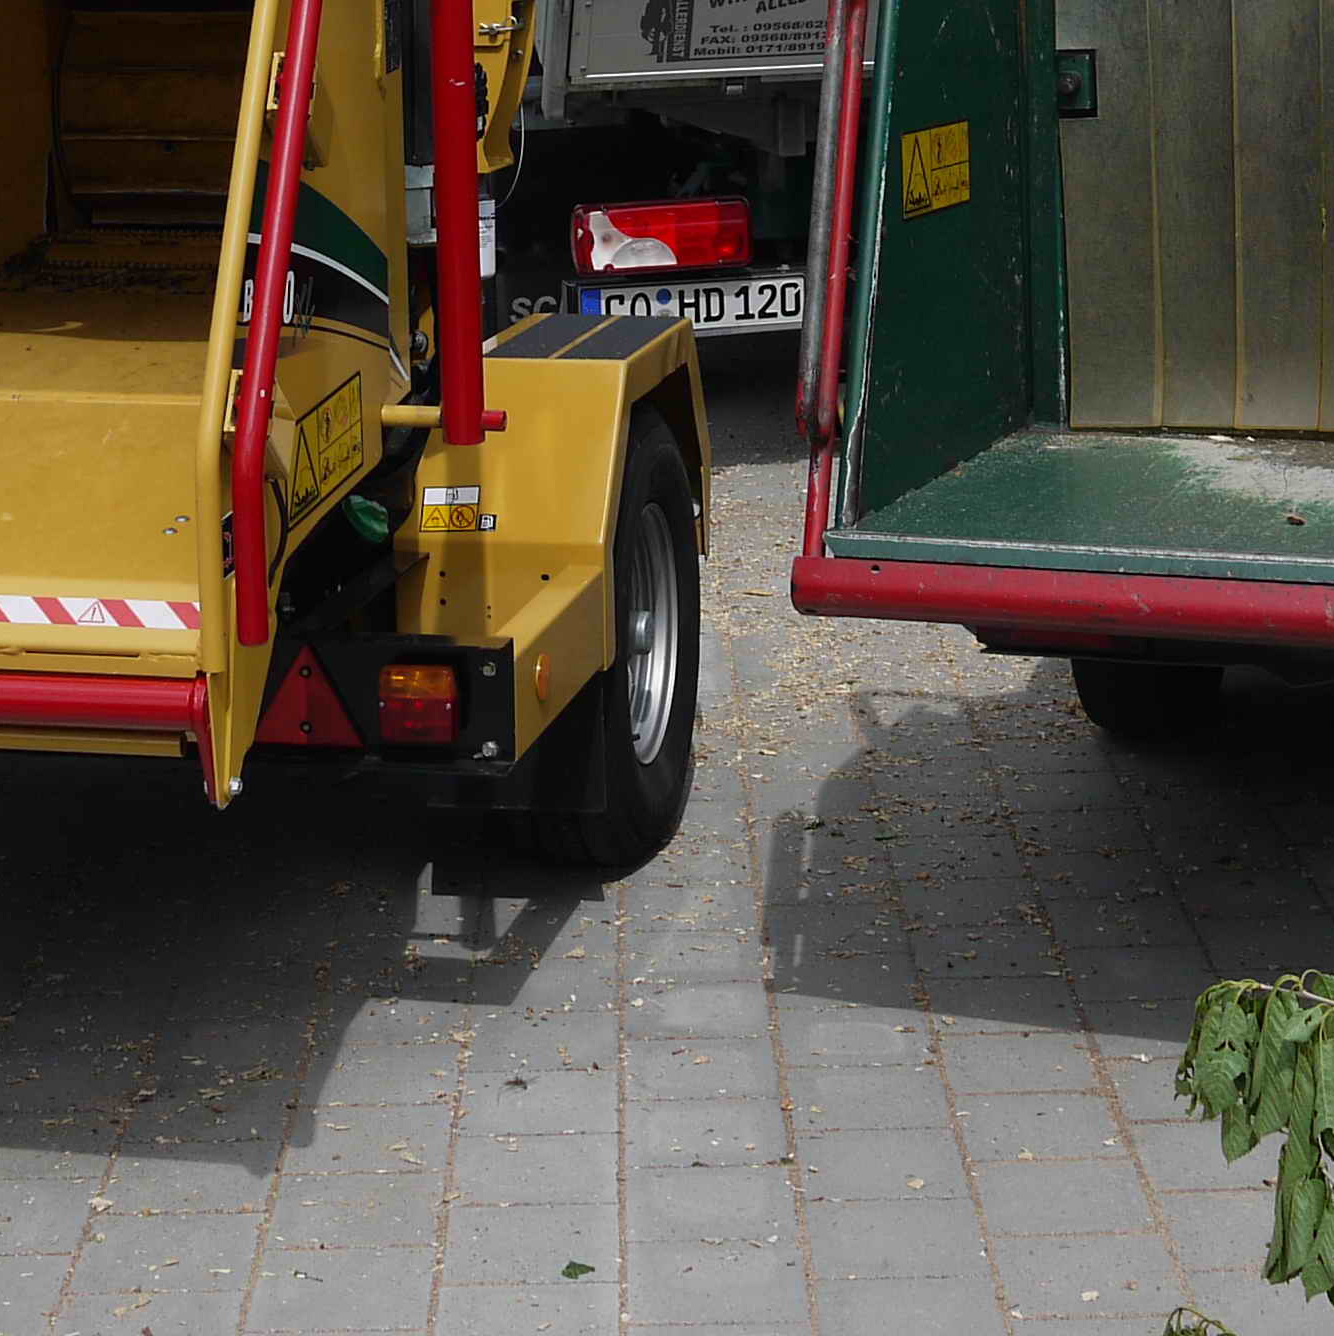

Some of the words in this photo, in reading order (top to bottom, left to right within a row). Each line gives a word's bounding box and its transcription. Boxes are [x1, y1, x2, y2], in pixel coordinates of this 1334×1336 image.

[693, 45, 741, 57] Mobil:
[678, 288, 725, 323] HD
[734, 282, 802, 321] 120
